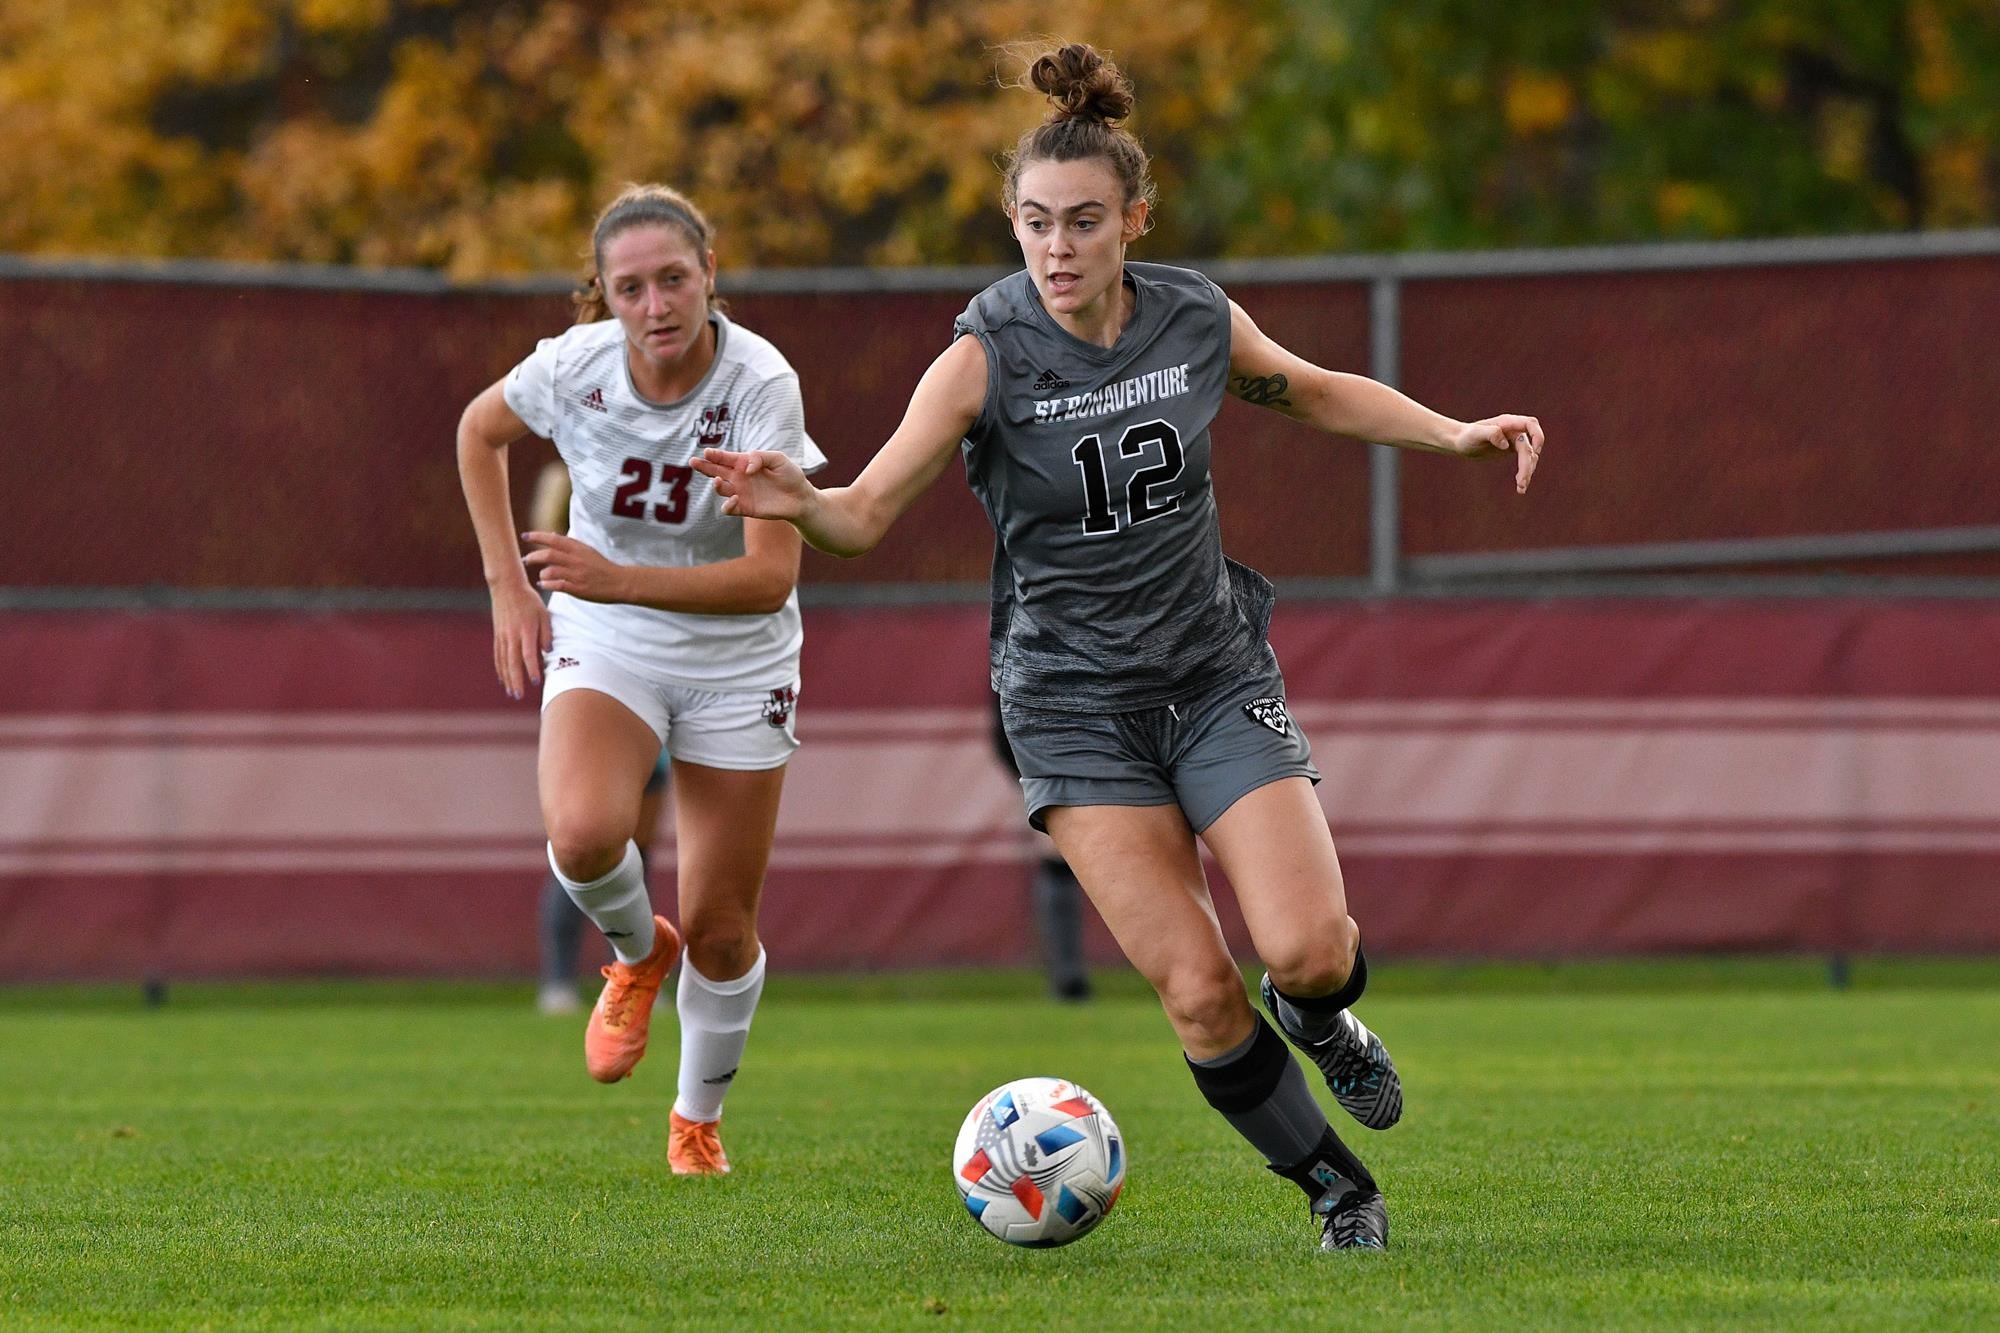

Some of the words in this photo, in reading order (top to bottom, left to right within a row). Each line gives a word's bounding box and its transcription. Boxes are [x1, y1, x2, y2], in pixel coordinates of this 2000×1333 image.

[1032, 399, 1062, 424] ST.
[1064, 363, 1190, 421] BONAVENTURE
[1033, 380, 1070, 390] adidas
[612, 457, 693, 525] 23
[1071, 418, 1186, 536] 12
